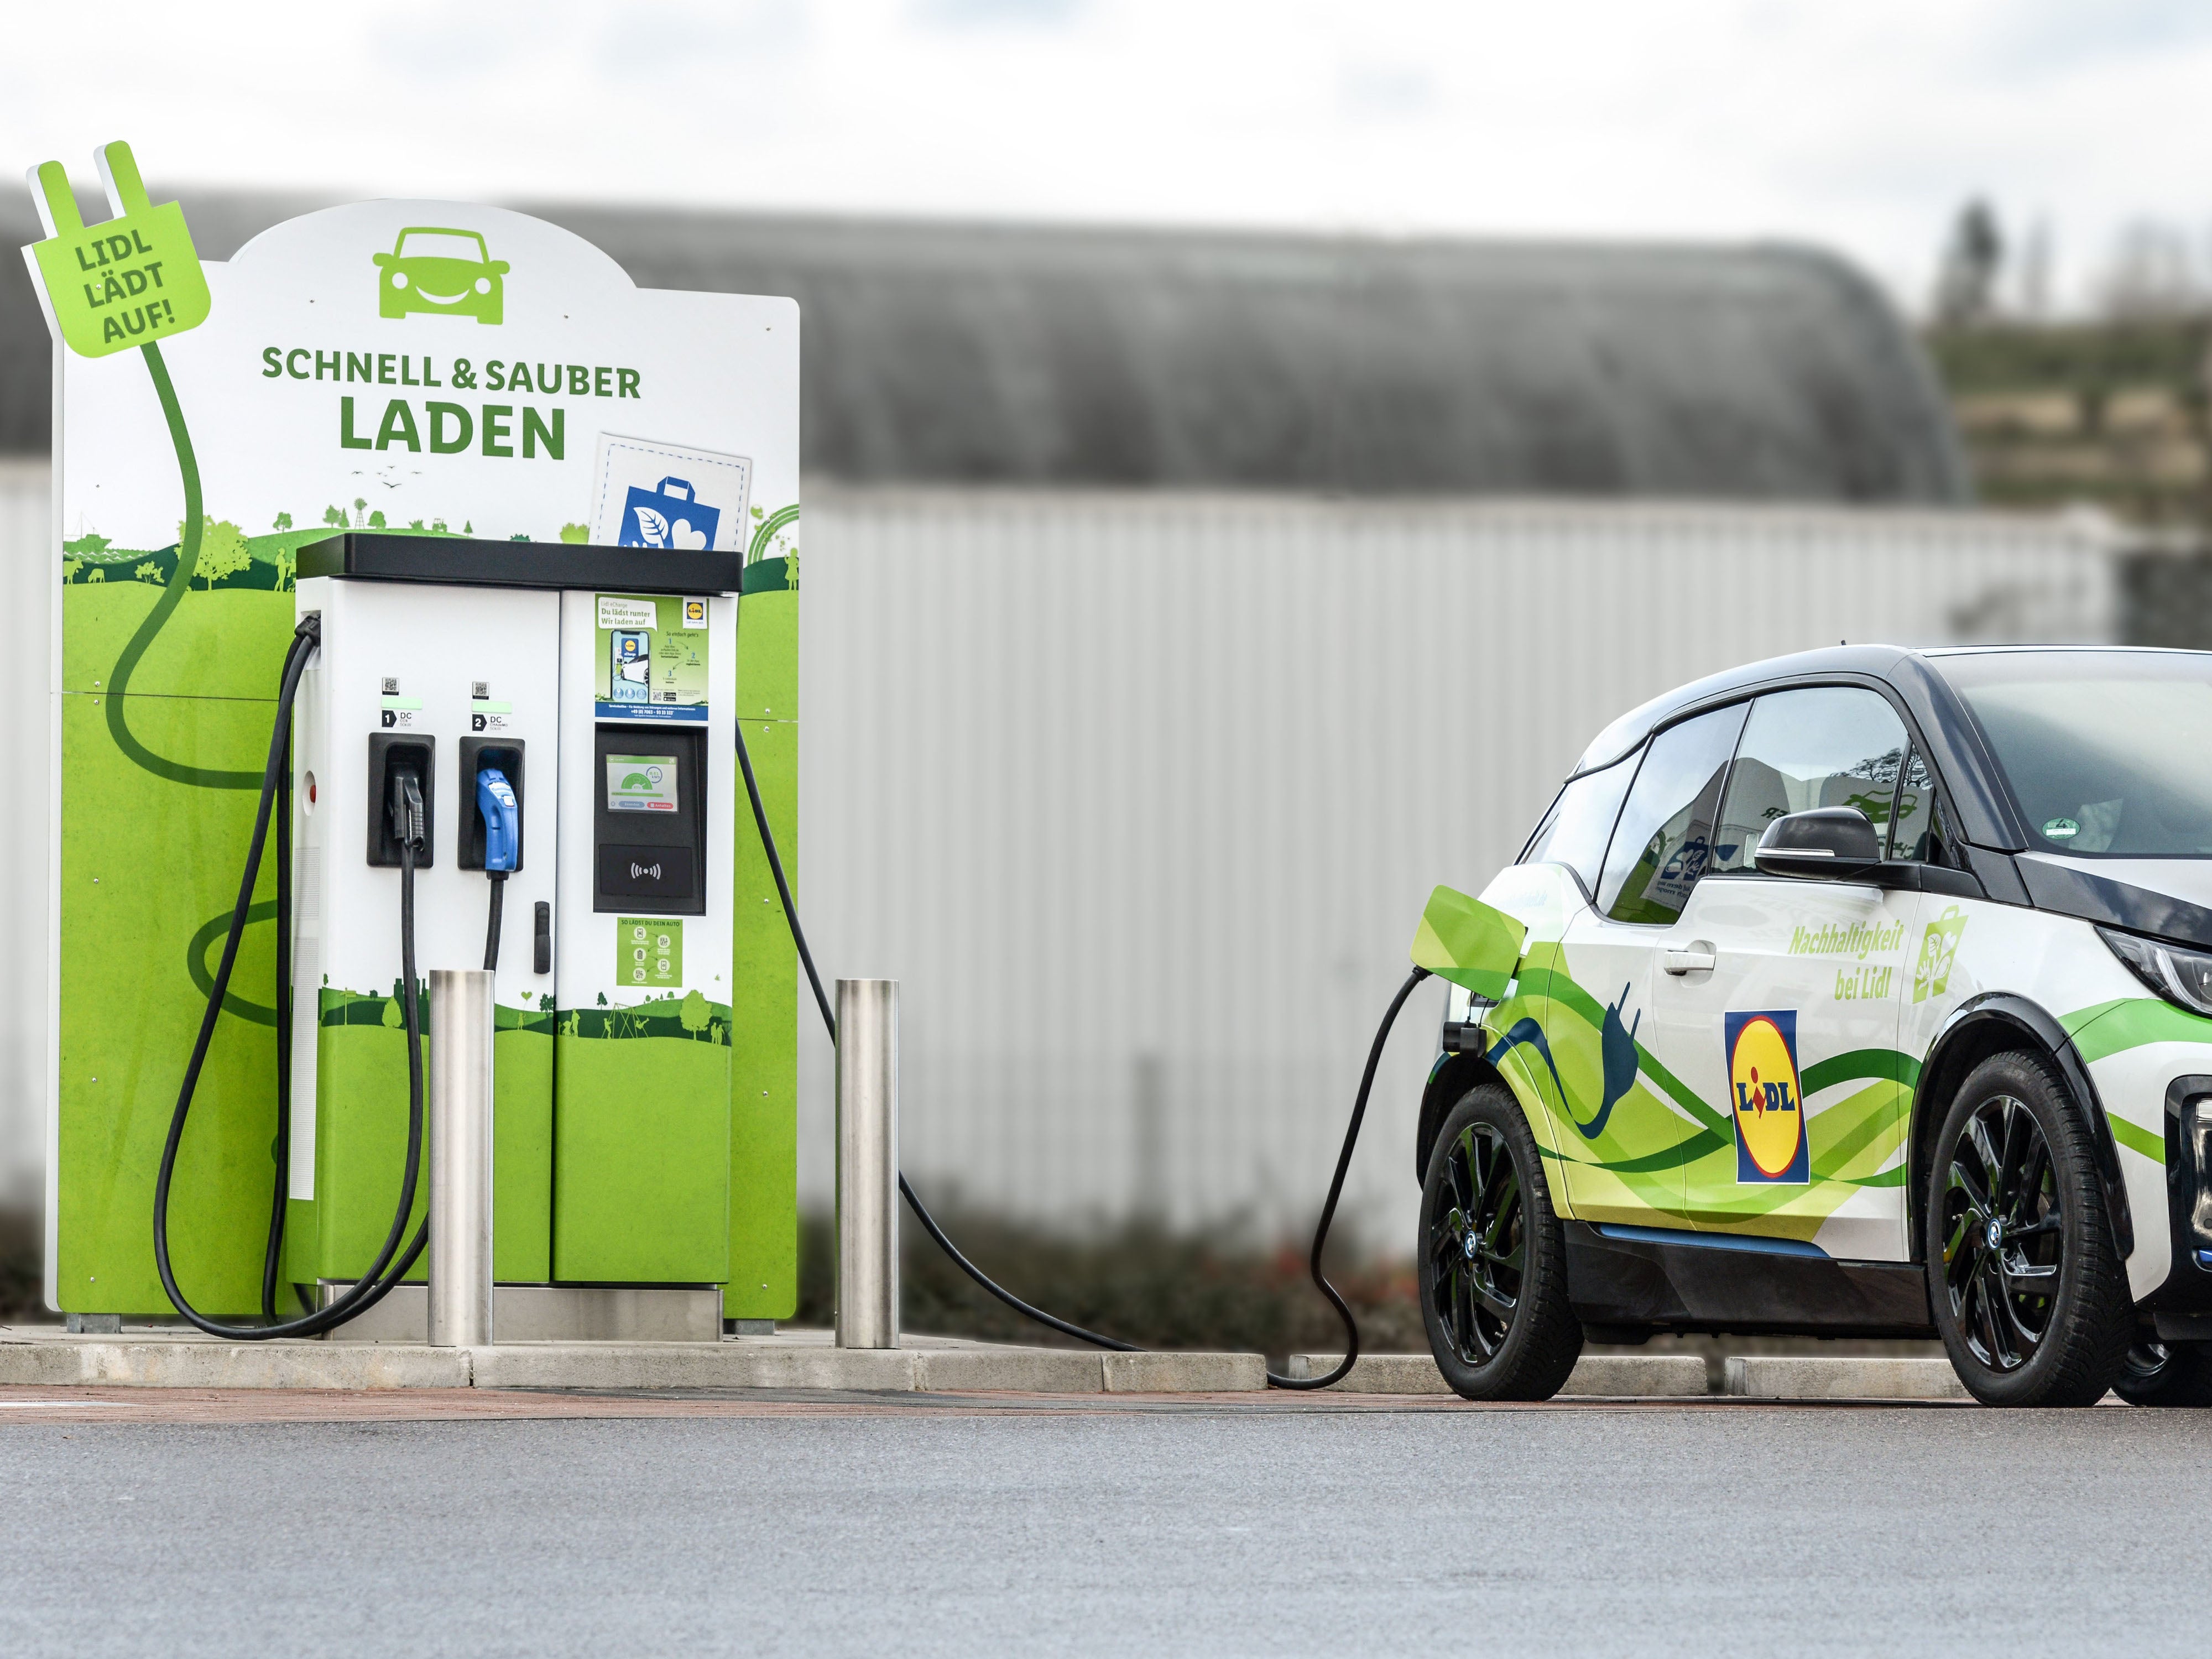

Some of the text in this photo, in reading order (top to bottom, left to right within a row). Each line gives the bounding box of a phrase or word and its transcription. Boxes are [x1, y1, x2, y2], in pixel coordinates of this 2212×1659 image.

[75, 229, 153, 272] LIDL
[84, 261, 163, 309] LÄDT
[103, 299, 175, 343] AUF!
[262, 347, 641, 399] SCHNELL & SAUBER
[341, 396, 565, 461] LADEN
[385, 714, 390, 723] 1
[474, 718, 482, 727] 2
[2056, 819, 2067, 828] 4
[1787, 920, 1904, 960] Nachhaltigkeit
[1834, 967, 1892, 1000] bei Lidl
